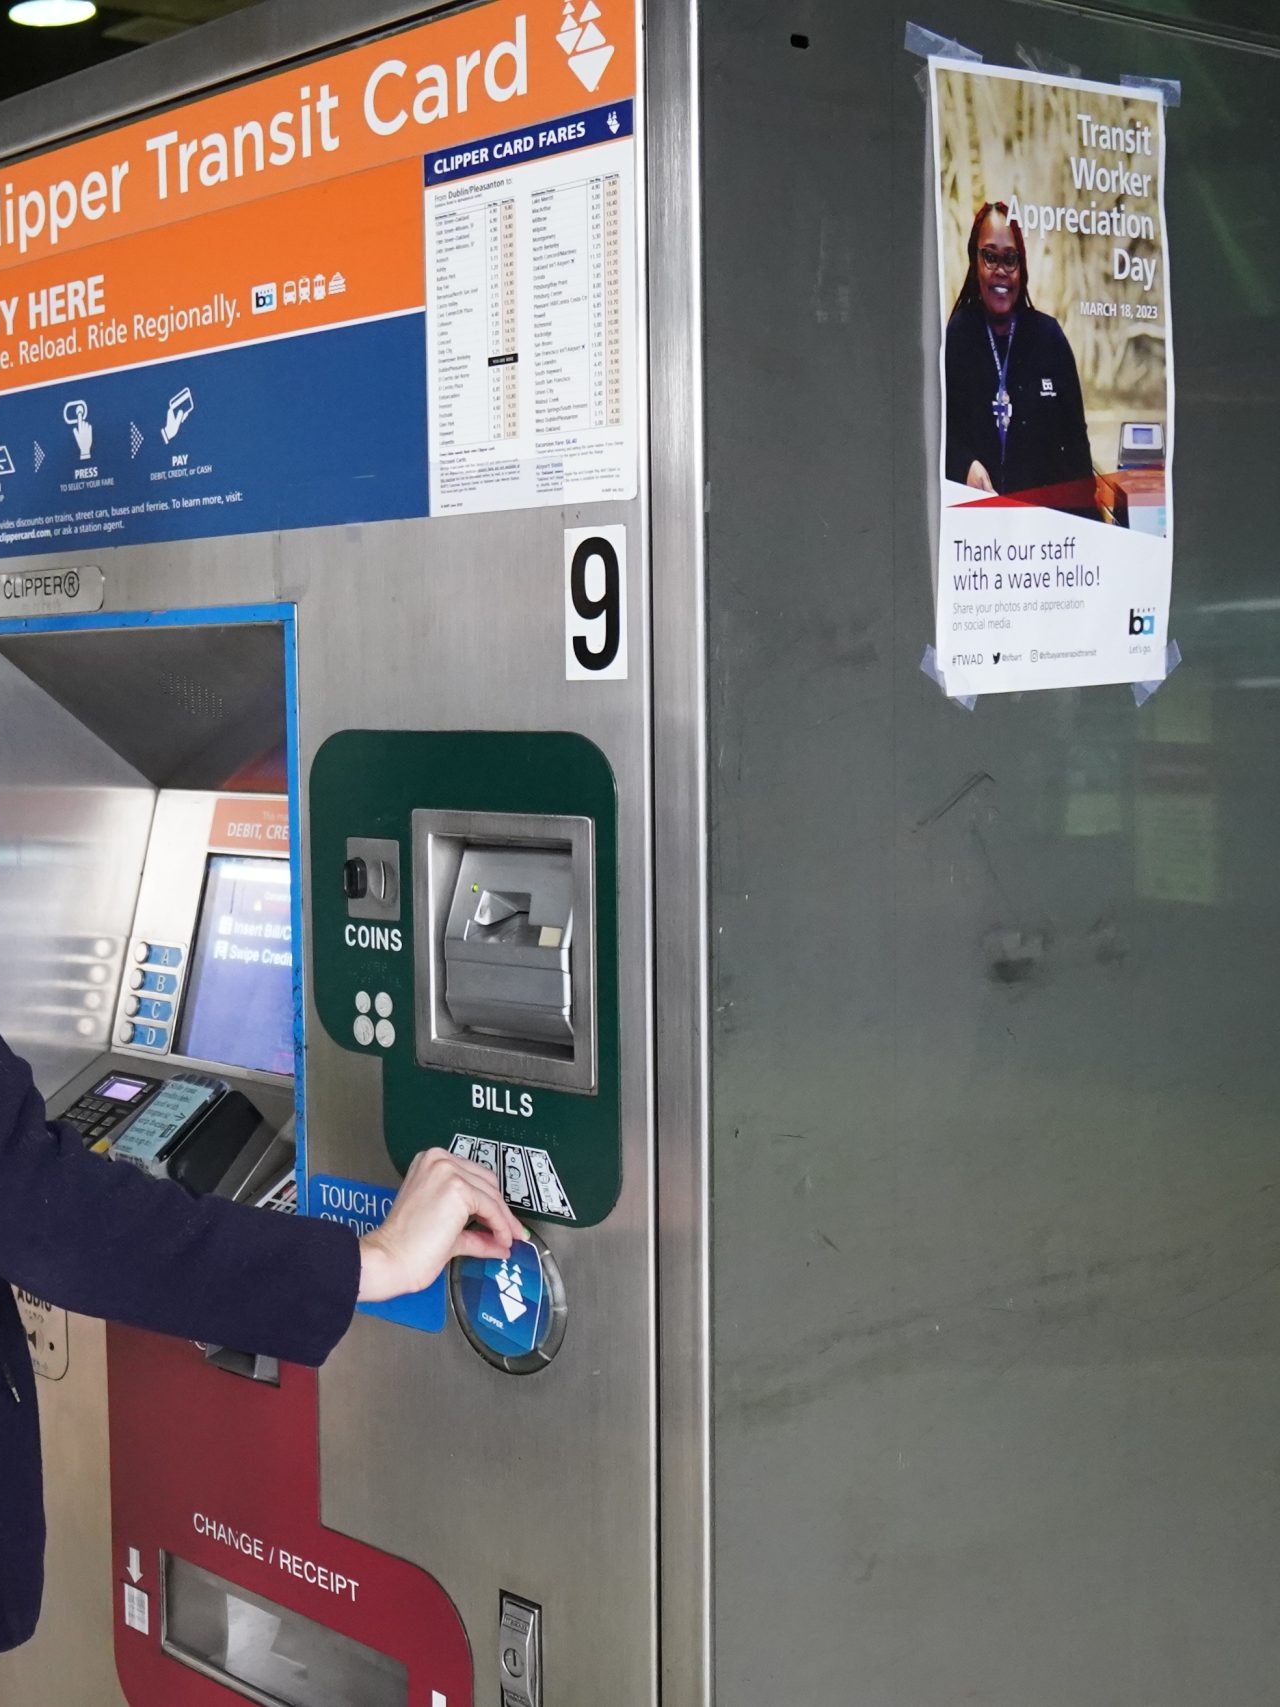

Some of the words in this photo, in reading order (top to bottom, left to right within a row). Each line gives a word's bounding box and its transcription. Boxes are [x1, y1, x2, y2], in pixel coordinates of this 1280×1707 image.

[146, 84, 339, 188] Transit
[362, 15, 528, 137] Card
[434, 147, 489, 175] CLIPPER
[493, 136, 534, 160] CARD
[538, 121, 586, 147] FARES
[1077, 114, 1152, 156] Transit
[1070, 156, 1152, 198] Worker
[1006, 195, 1155, 240] Appreciation
[1113, 248, 1157, 291] Day
[29, 275, 105, 329] HERE
[1080, 301, 1117, 318] MARCH
[1120, 303, 1134, 320] 18,
[1136, 304, 1158, 319] 2023
[19, 332, 83, 365] Reload.
[87, 321, 128, 350] Ride
[134, 293, 241, 342] Regionally.
[74, 466, 99, 480] PRESS
[172, 454, 189, 467] PAY
[196, 465, 213, 476] CASH
[16, 516, 44, 528] discounts
[45, 515, 54, 525] on
[75, 510, 94, 521] street
[111, 506, 130, 516] buses
[131, 503, 145, 514] and
[172, 499, 181, 509] To
[182, 498, 201, 508] learn
[202, 495, 224, 505] more,
[53, 528, 61, 536] or
[62, 525, 73, 536] ask
[74, 525, 79, 534] a
[79, 522, 102, 534] station
[953, 538, 1002, 562] Thank
[1007, 544, 1036, 560] our
[1040, 536, 1076, 560] staff
[953, 567, 989, 591] with
[994, 573, 1003, 590] a
[1008, 571, 1051, 589] wave
[1056, 564, 1100, 588] hello!
[571, 536, 620, 671] 9
[952, 602, 974, 615] Share
[975, 602, 993, 616] your
[994, 601, 1021, 614] photos
[1022, 600, 1038, 612] and
[1039, 599, 1085, 613] appreciation
[952, 620, 962, 632] on
[964, 618, 986, 631] social
[951, 653, 984, 667] #TWAD
[227, 821, 263, 840] DEBIT,
[266, 824, 290, 840] CRE
[233, 921, 262, 937] Insert
[263, 922, 292, 941] Bill/C
[344, 924, 403, 952] COINS
[161, 948, 170, 965] A
[229, 944, 259, 965] Swipe
[156, 974, 166, 992] B
[151, 1001, 161, 1019] C
[146, 1027, 156, 1045] D
[471, 1083, 534, 1118] BILLS
[319, 1183, 377, 1218] TOUCH
[193, 1512, 264, 1561] CHANGE
[268, 1546, 275, 1565] /
[279, 1550, 360, 1602] RECEIPT
